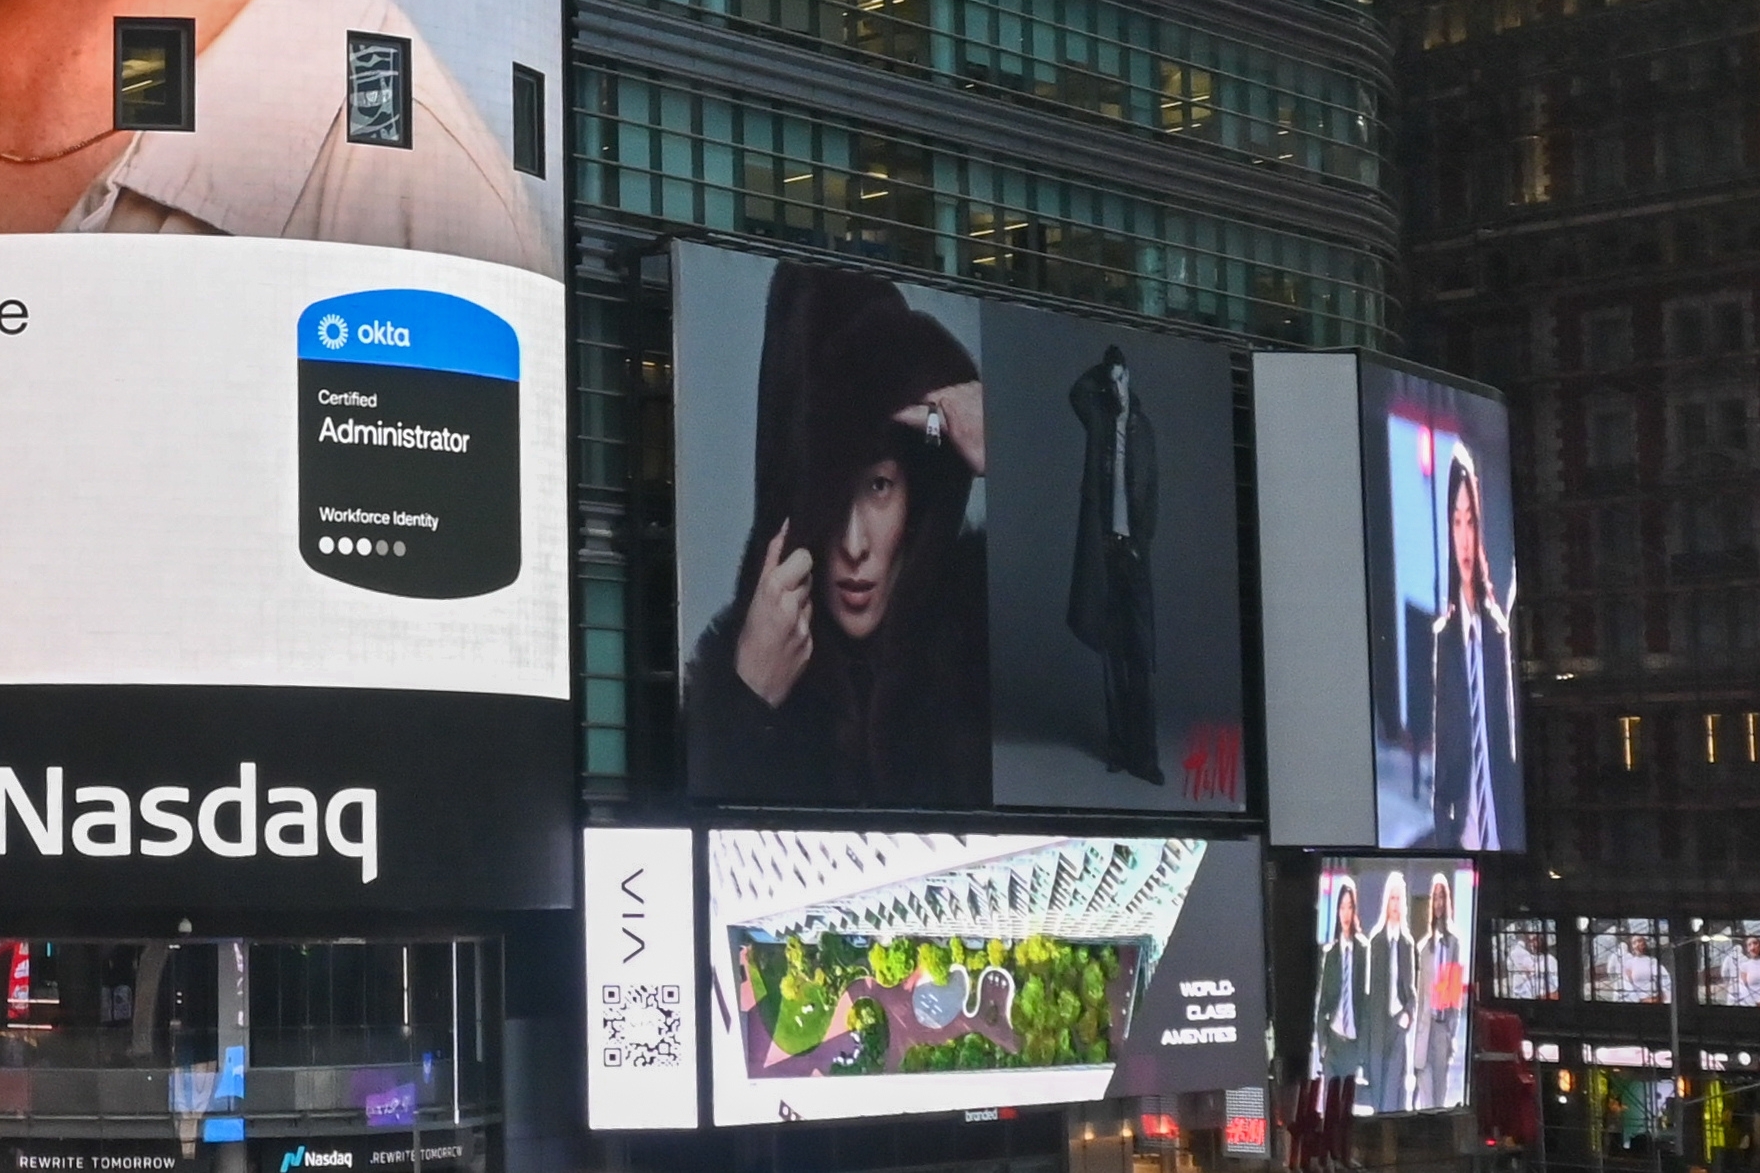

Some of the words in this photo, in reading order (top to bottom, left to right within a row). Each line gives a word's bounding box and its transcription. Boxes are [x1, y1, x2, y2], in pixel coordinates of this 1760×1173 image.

[357, 319, 411, 348] okta
[318, 389, 378, 408] Certified
[318, 416, 471, 453] Administrator
[319, 506, 391, 525] Workforce
[392, 510, 439, 532] Identity
[1186, 1003, 1237, 1021] CLASS
[19, 1155, 83, 1169] REWRITE
[91, 1156, 176, 1169] TOMORROW
[304, 1150, 353, 1169] Nasdaq
[419, 1145, 463, 1161] TOMORROW
